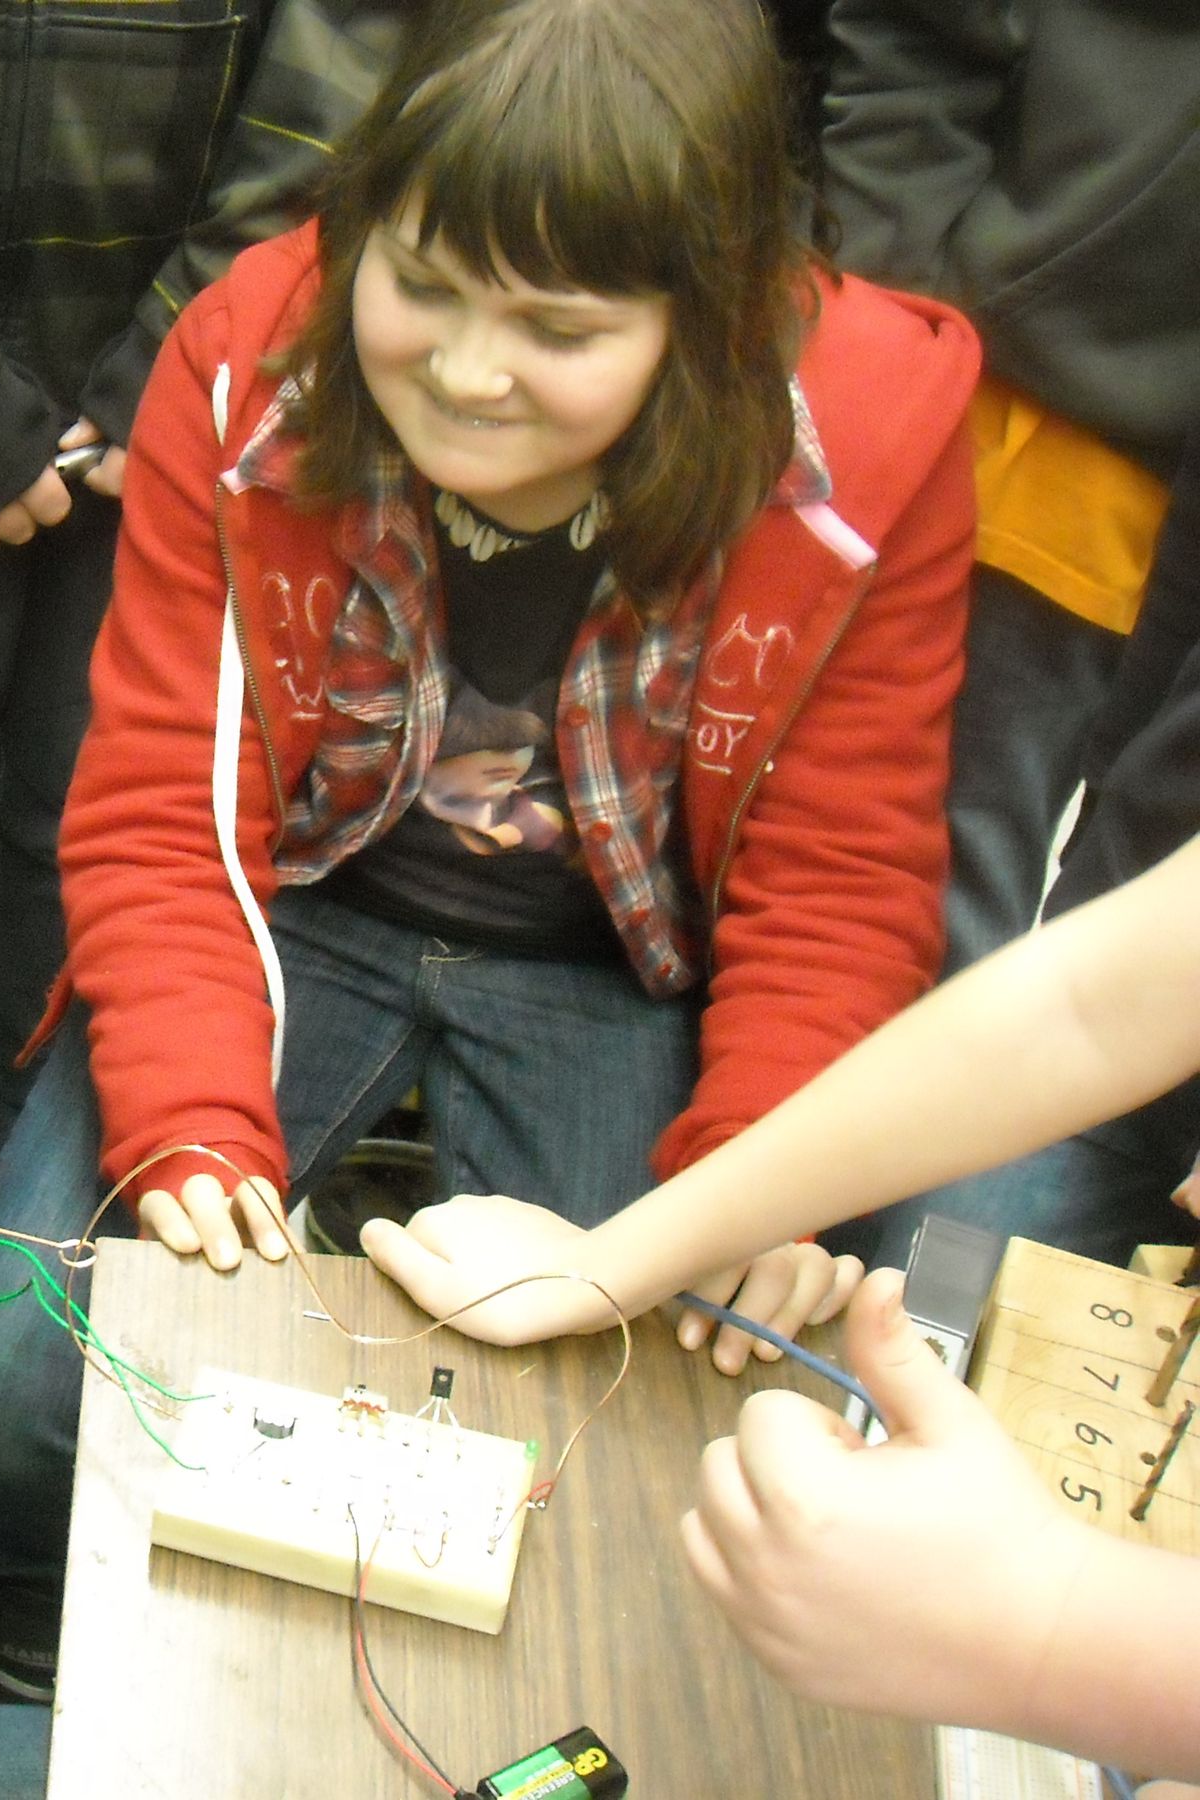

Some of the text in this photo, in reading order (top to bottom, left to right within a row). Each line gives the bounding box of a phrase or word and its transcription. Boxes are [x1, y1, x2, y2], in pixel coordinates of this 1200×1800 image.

[1061, 1302, 1133, 1512] 8 7 6 5
[574, 1746, 609, 1776] GP
